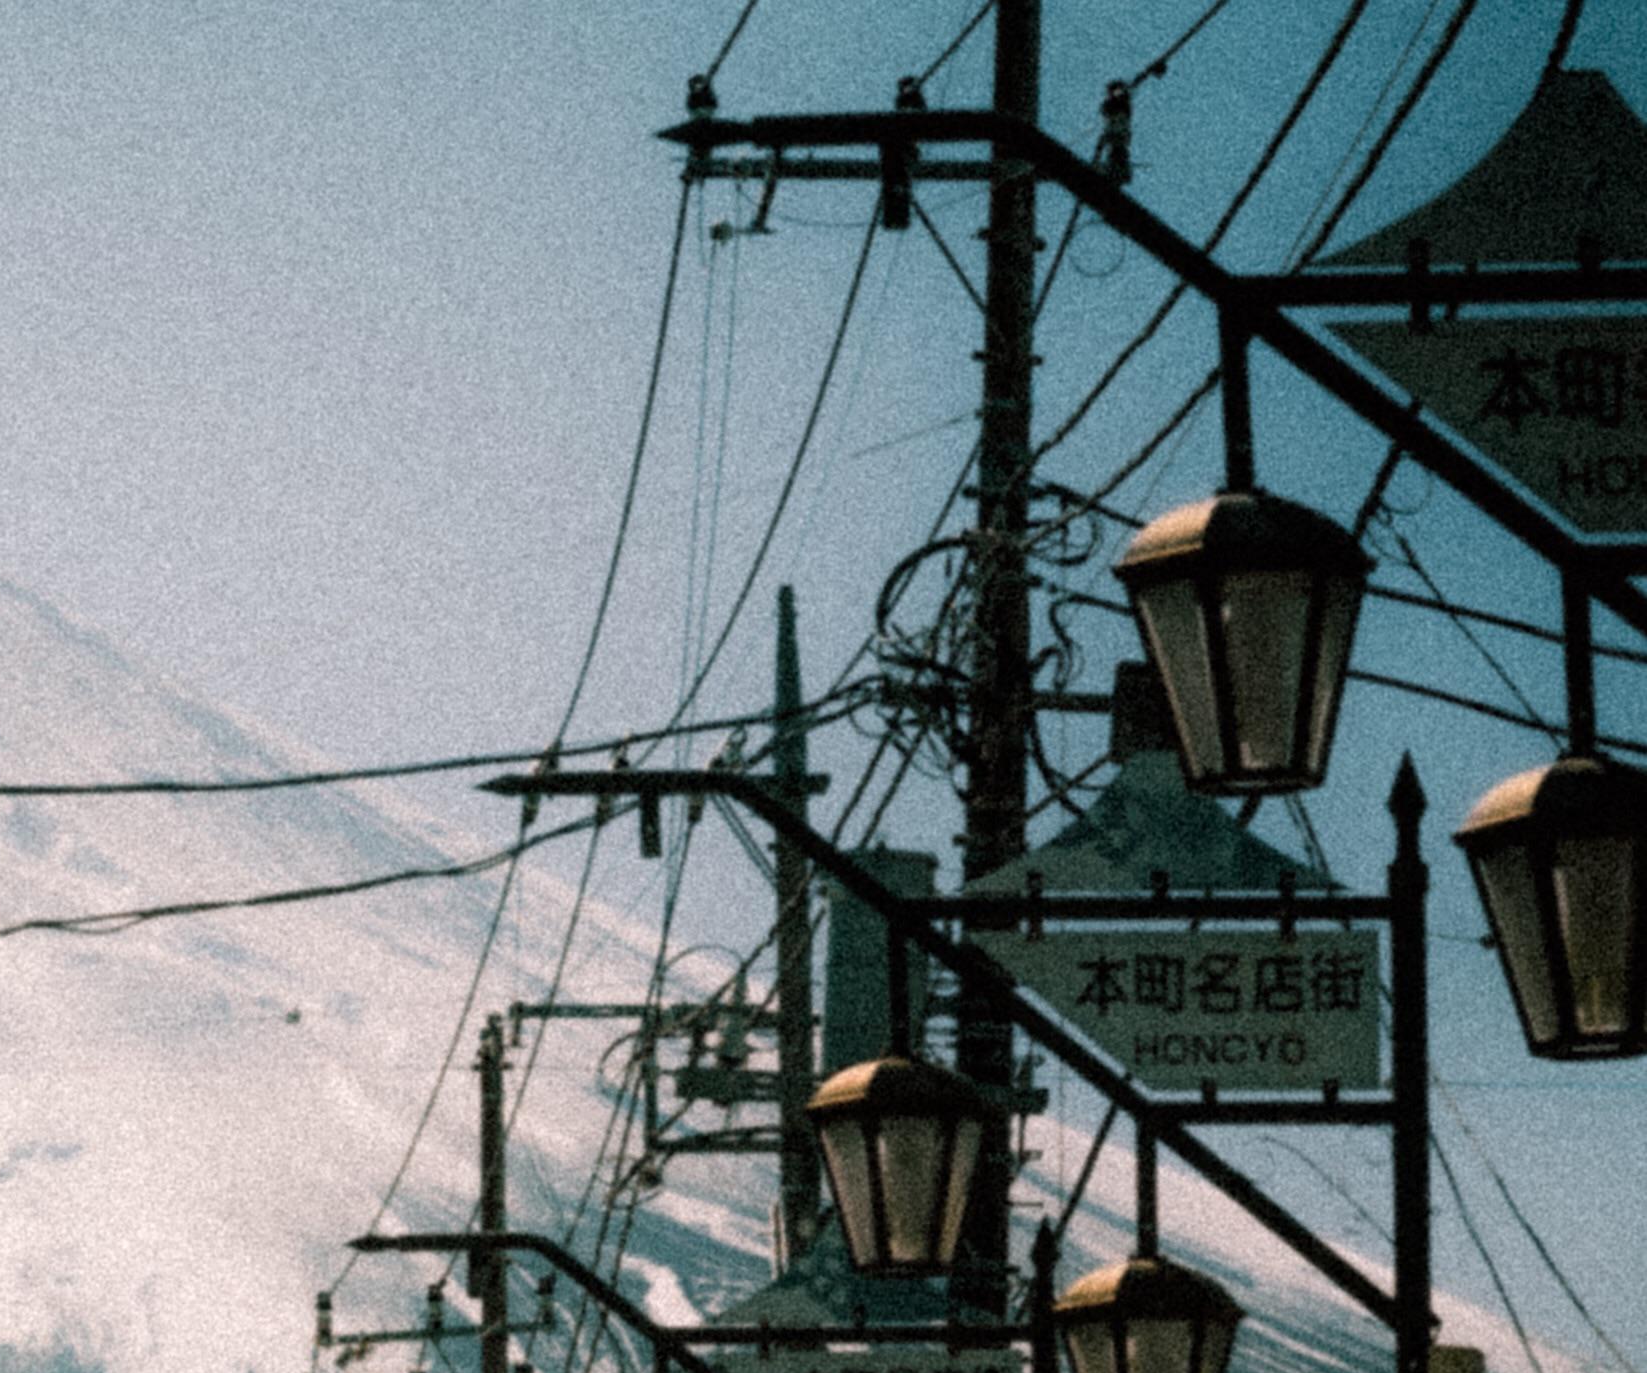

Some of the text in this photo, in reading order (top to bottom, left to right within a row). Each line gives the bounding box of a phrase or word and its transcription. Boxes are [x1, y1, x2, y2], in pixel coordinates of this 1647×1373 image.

[1478, 347, 1647, 434] 本町
[1076, 952, 1365, 1017] 本町名店街
